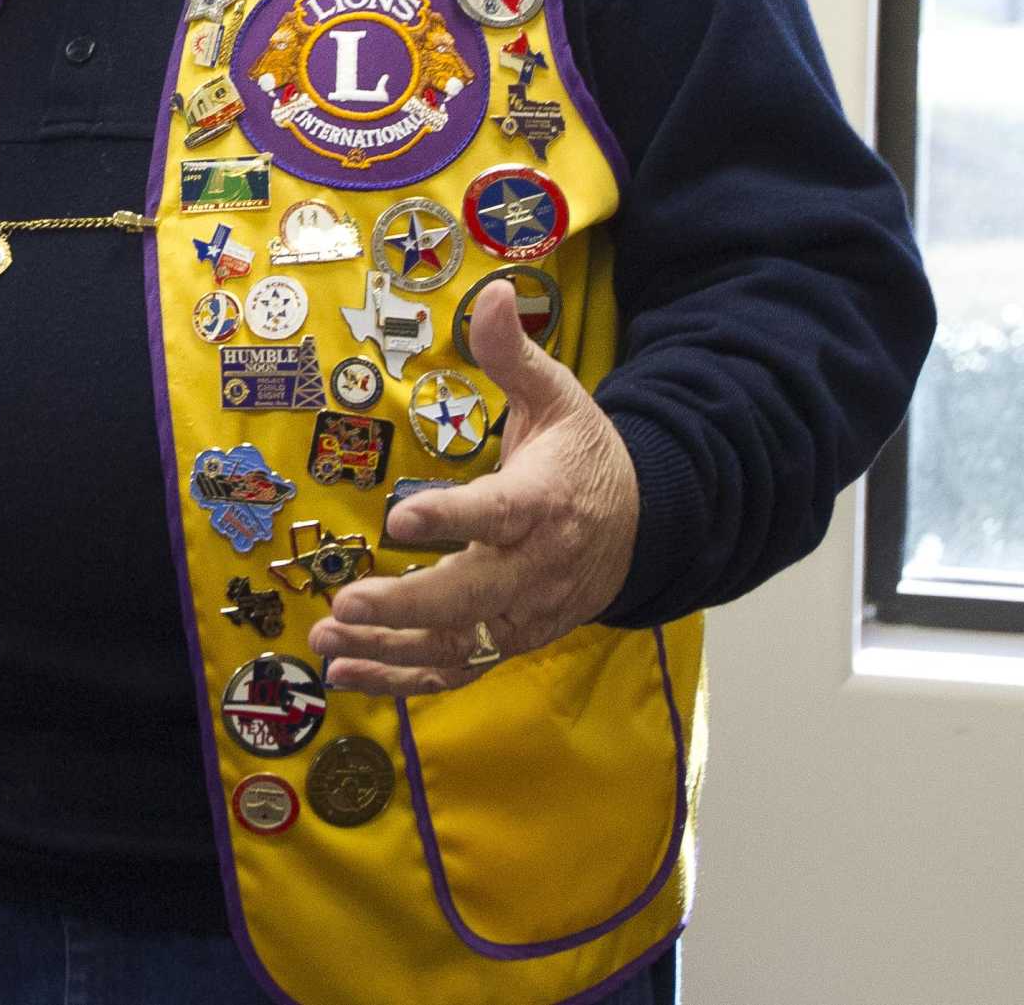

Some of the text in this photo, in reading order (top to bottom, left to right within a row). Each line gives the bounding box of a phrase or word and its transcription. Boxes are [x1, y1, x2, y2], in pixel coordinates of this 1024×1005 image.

[327, 29, 390, 103] L
[293, 108, 426, 148] INTERNATIONAL
[223, 349, 299, 364] HUMBLE
